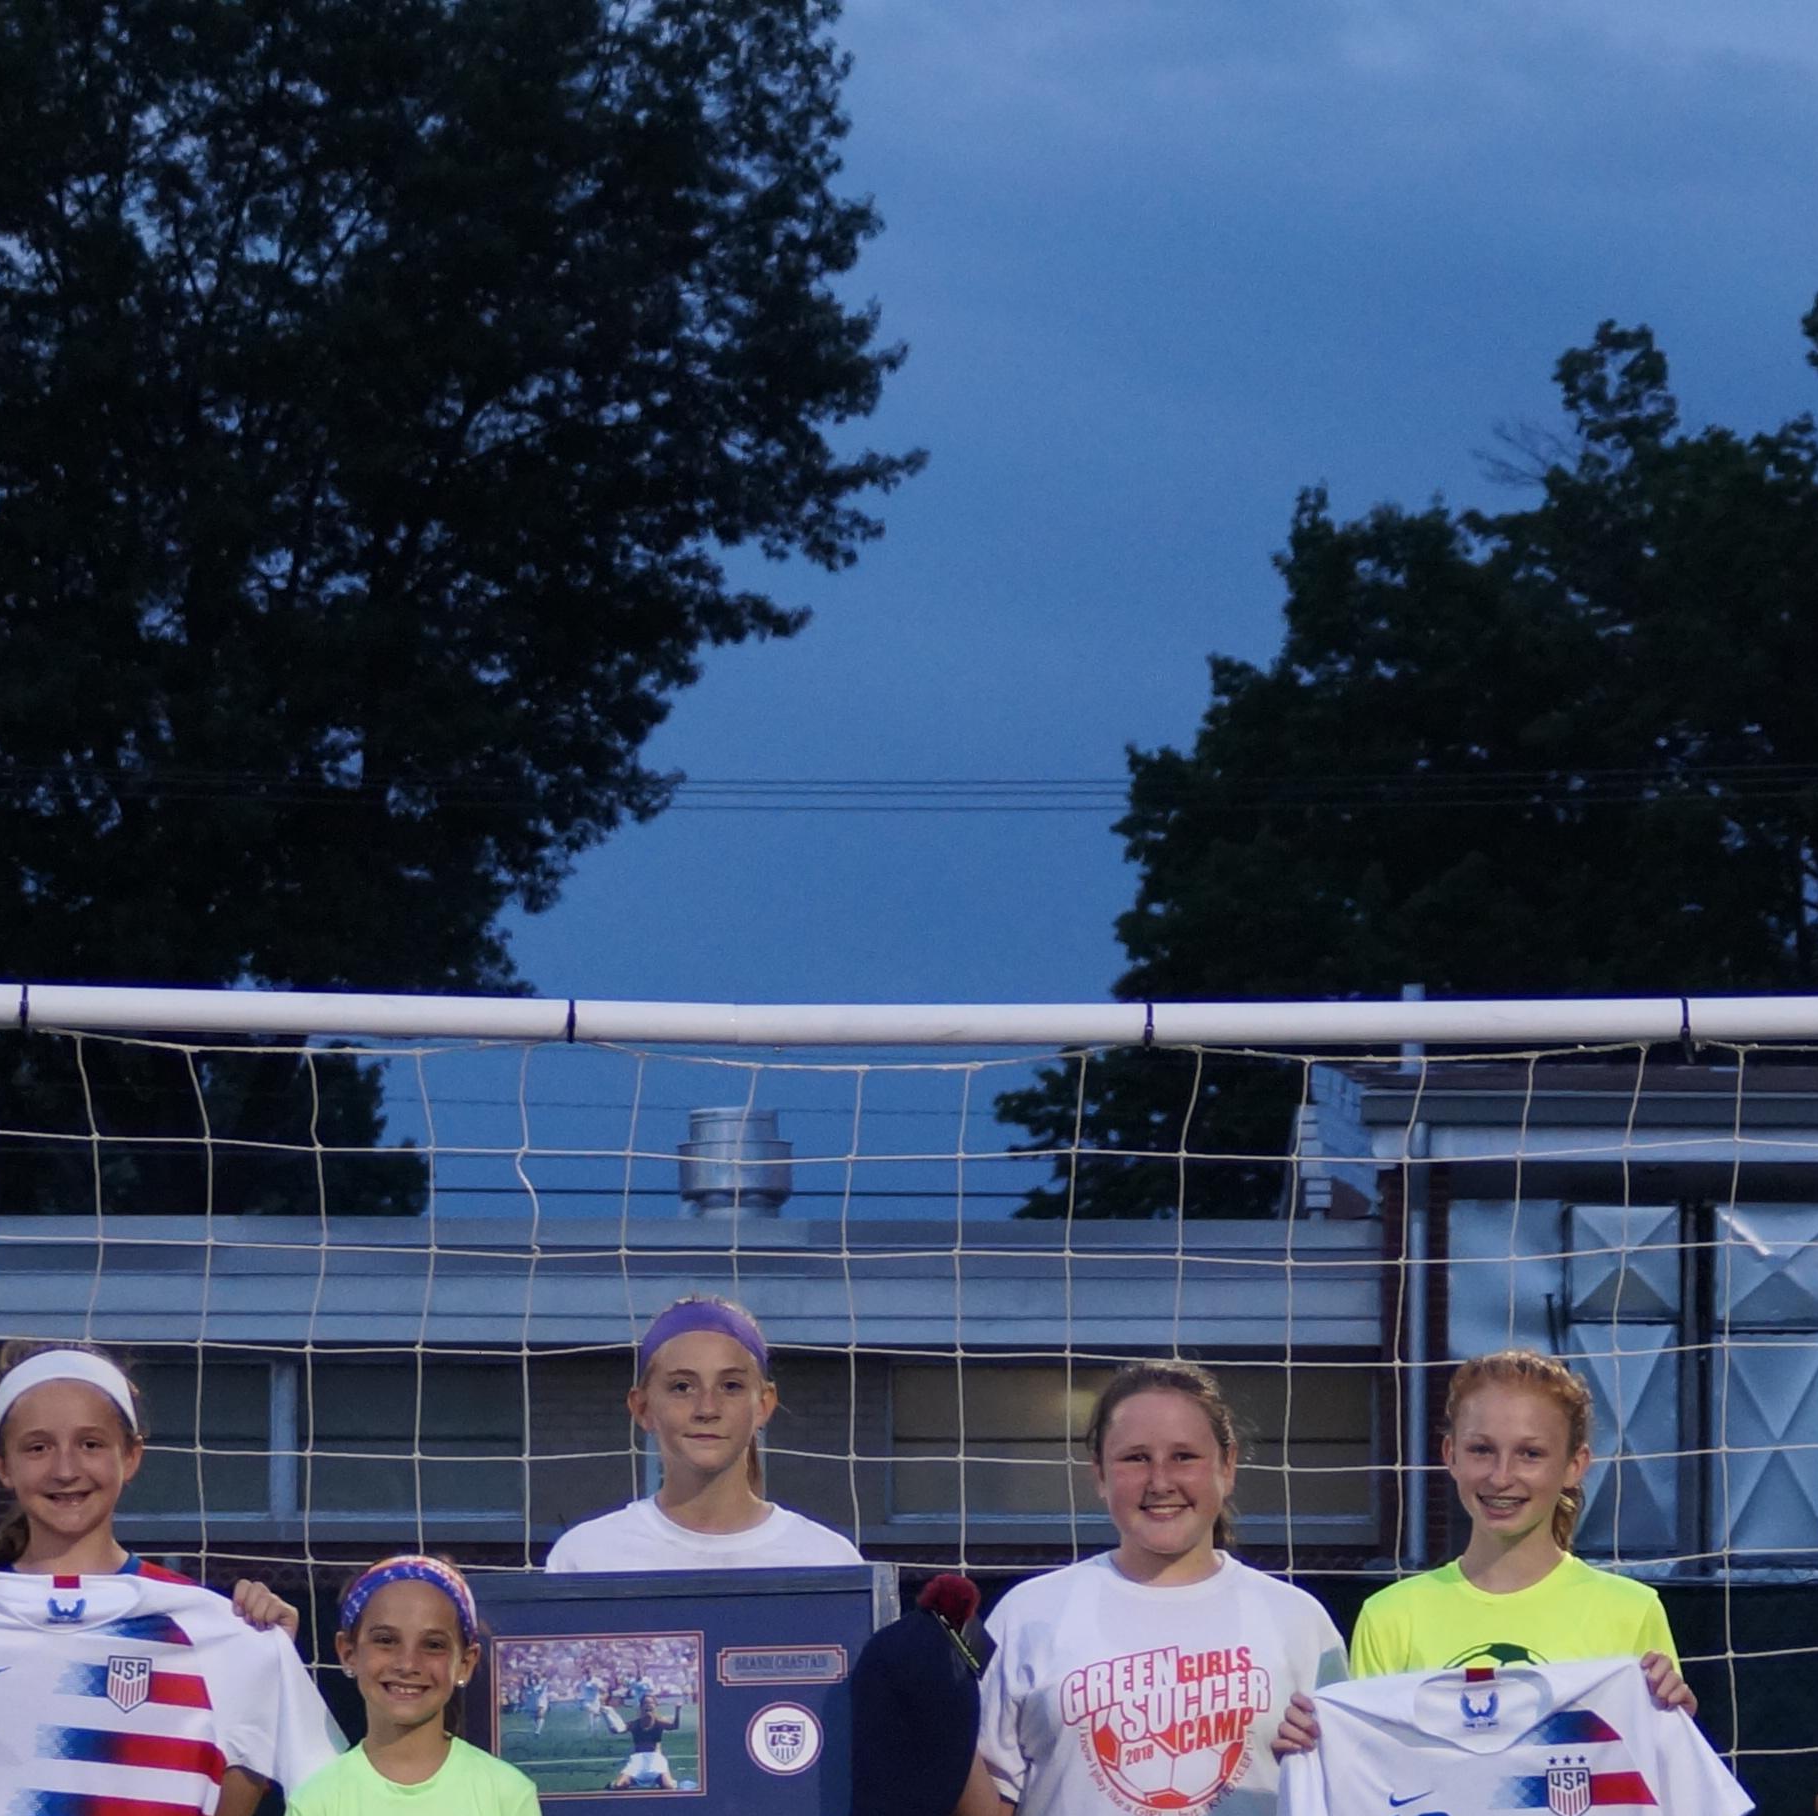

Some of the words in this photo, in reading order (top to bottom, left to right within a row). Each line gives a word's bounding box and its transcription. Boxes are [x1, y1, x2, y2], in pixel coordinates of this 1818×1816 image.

[112, 1660, 148, 1680] USA
[1060, 1645, 1179, 1726] GREEN
[1177, 1646, 1253, 1684] GIRLS
[1121, 1666, 1271, 1744] SOCCER
[1177, 1706, 1254, 1755] CAMP
[1550, 1771, 1589, 1791] USA
